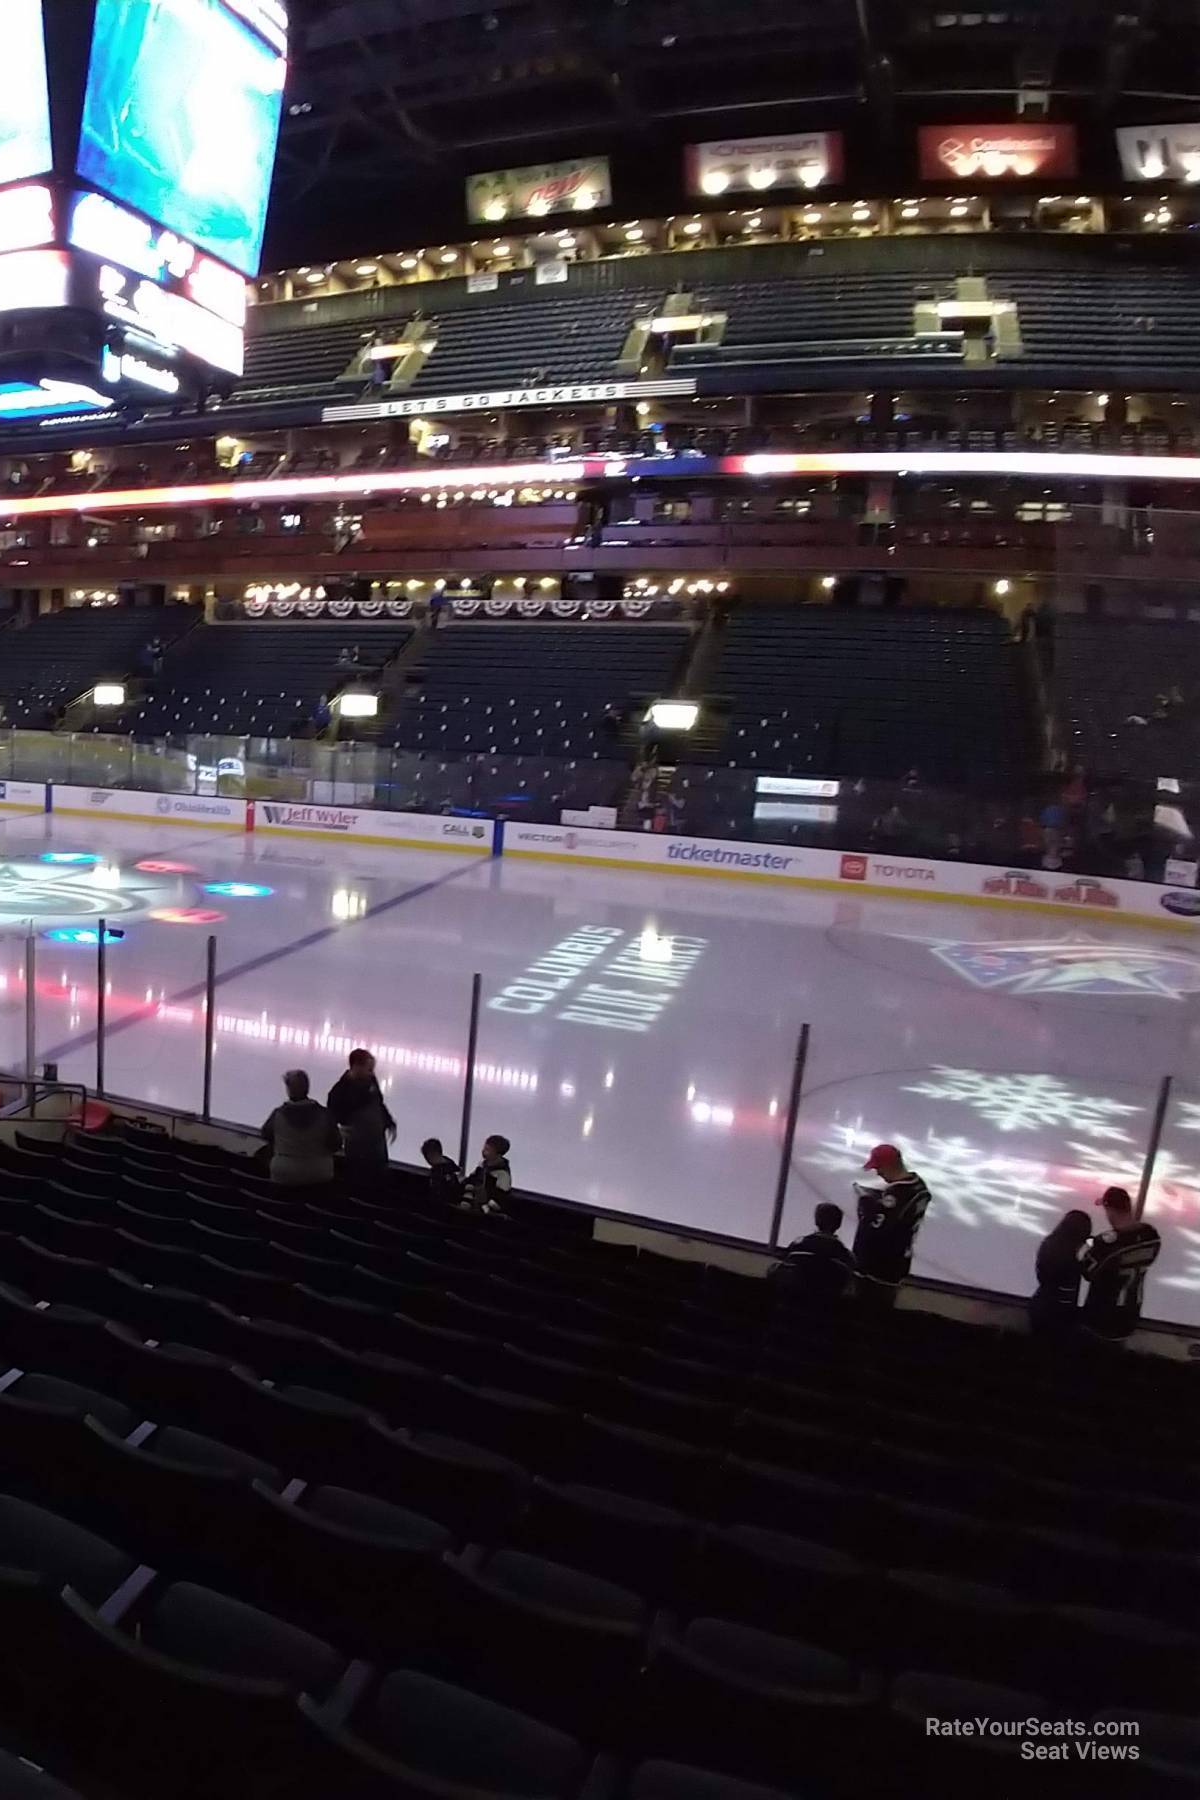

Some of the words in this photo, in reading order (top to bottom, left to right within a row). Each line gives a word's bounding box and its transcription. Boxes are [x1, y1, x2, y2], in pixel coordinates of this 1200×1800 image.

[387, 397, 447, 415] LET'S
[462, 395, 491, 407] GO
[502, 385, 618, 405] JACKETS
[287, 806, 314, 821] Jeff
[315, 810, 360, 825] Wyler
[517, 832, 562, 844] VECTOR
[667, 842, 793, 870] ticketmaster
[873, 863, 936, 881] TOYOTA
[487, 924, 625, 1015] COLUMBUS
